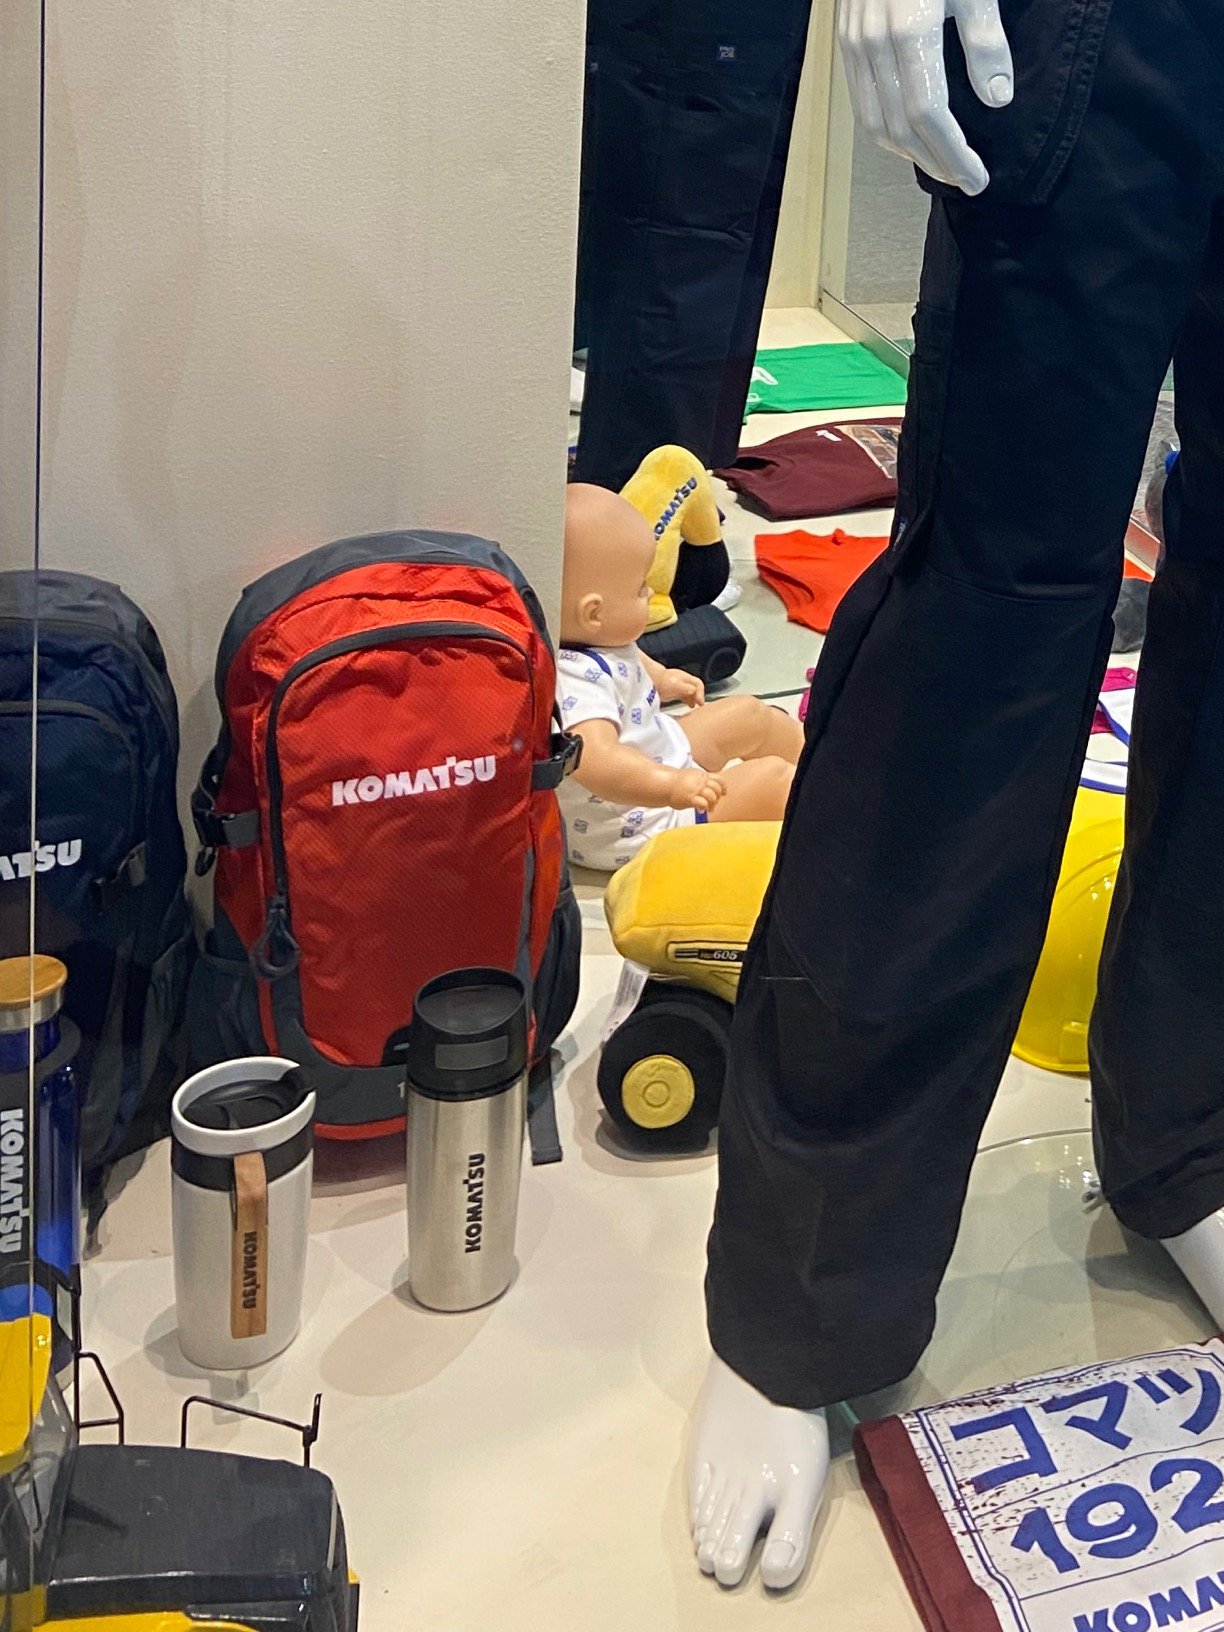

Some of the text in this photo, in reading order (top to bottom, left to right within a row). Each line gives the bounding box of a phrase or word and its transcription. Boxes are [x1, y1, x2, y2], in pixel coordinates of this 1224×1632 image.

[653, 477, 698, 541] OMATSU
[332, 754, 497, 807] KOMATSU
[0, 1108, 31, 1254] KOMATSU
[463, 1153, 486, 1254] KOMATSU
[242, 1231, 261, 1309] KOMATSU
[951, 1368, 1222, 1495] コマツ
